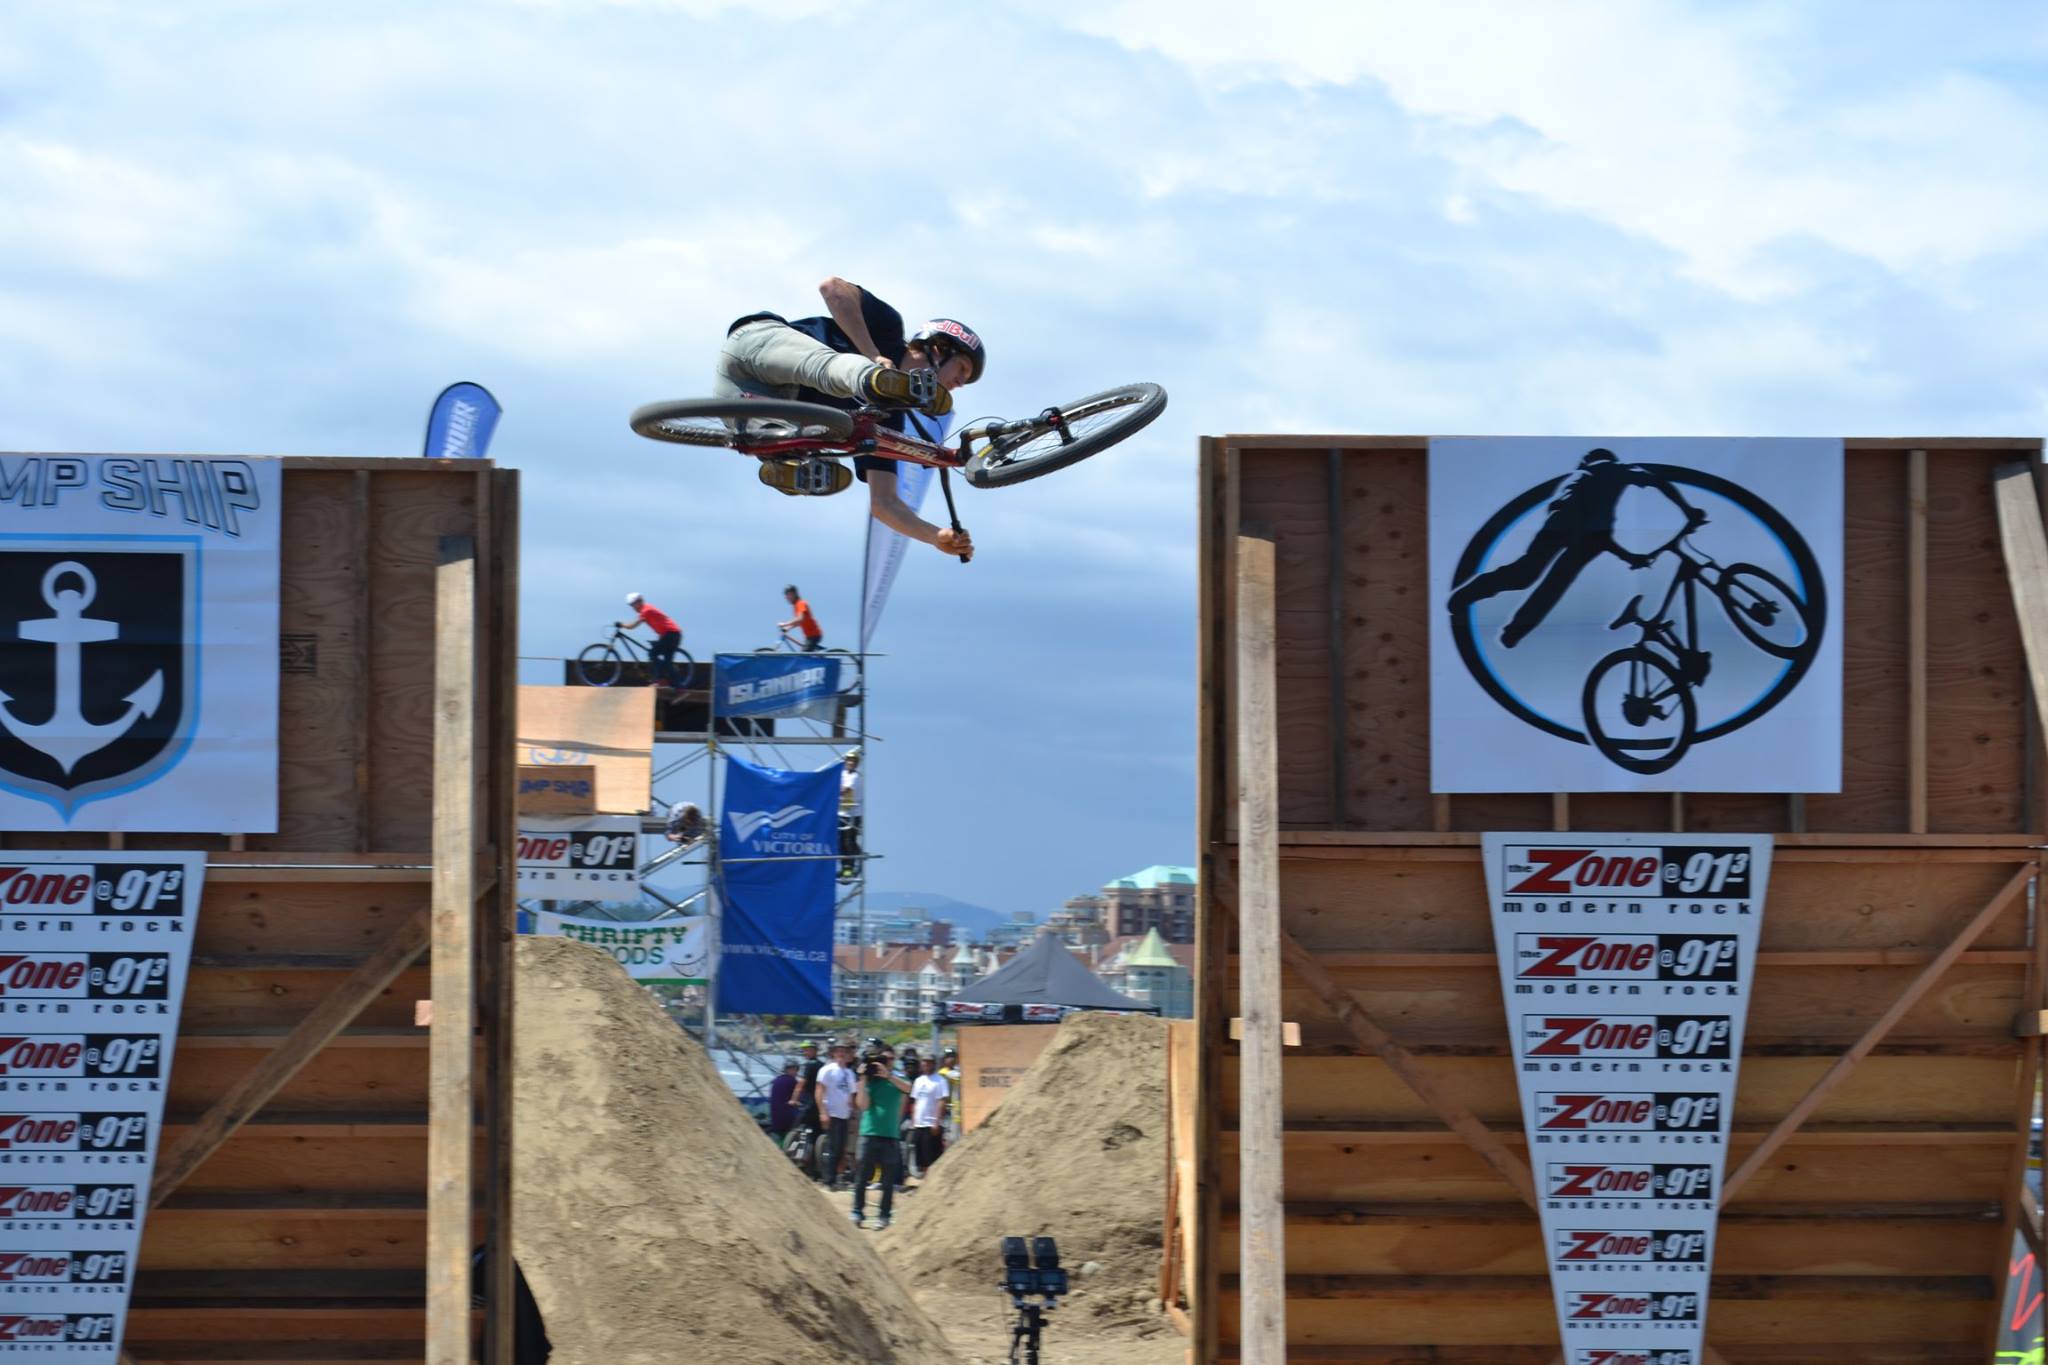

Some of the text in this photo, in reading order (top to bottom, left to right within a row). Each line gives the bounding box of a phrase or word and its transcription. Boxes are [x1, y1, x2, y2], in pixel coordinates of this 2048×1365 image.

[99, 459, 260, 538] SHIP
[517, 838, 568, 860] one
[752, 840, 833, 855] VICTORIA
[1507, 849, 1658, 893] Zone
[1508, 863, 1533, 874] the
[1502, 901, 1751, 915] modern rock
[0, 919, 184, 932] ern rock
[560, 923, 688, 945] THRIFTY
[600, 946, 664, 965] ODS
[1519, 937, 1655, 977] Zone
[1515, 983, 1739, 996] modern rock
[92, 1003, 169, 1014] rock
[1527, 1018, 1653, 1056] Zone
[1523, 1061, 1732, 1073] modern rock
[89, 1081, 161, 1092] rock
[1537, 1095, 1652, 1129] Zone
[1535, 1134, 1722, 1144] modern rock
[1548, 1166, 1652, 1196] Zone
[1558, 1232, 1652, 1259] Zone
[1568, 1294, 1650, 1318] Zone
